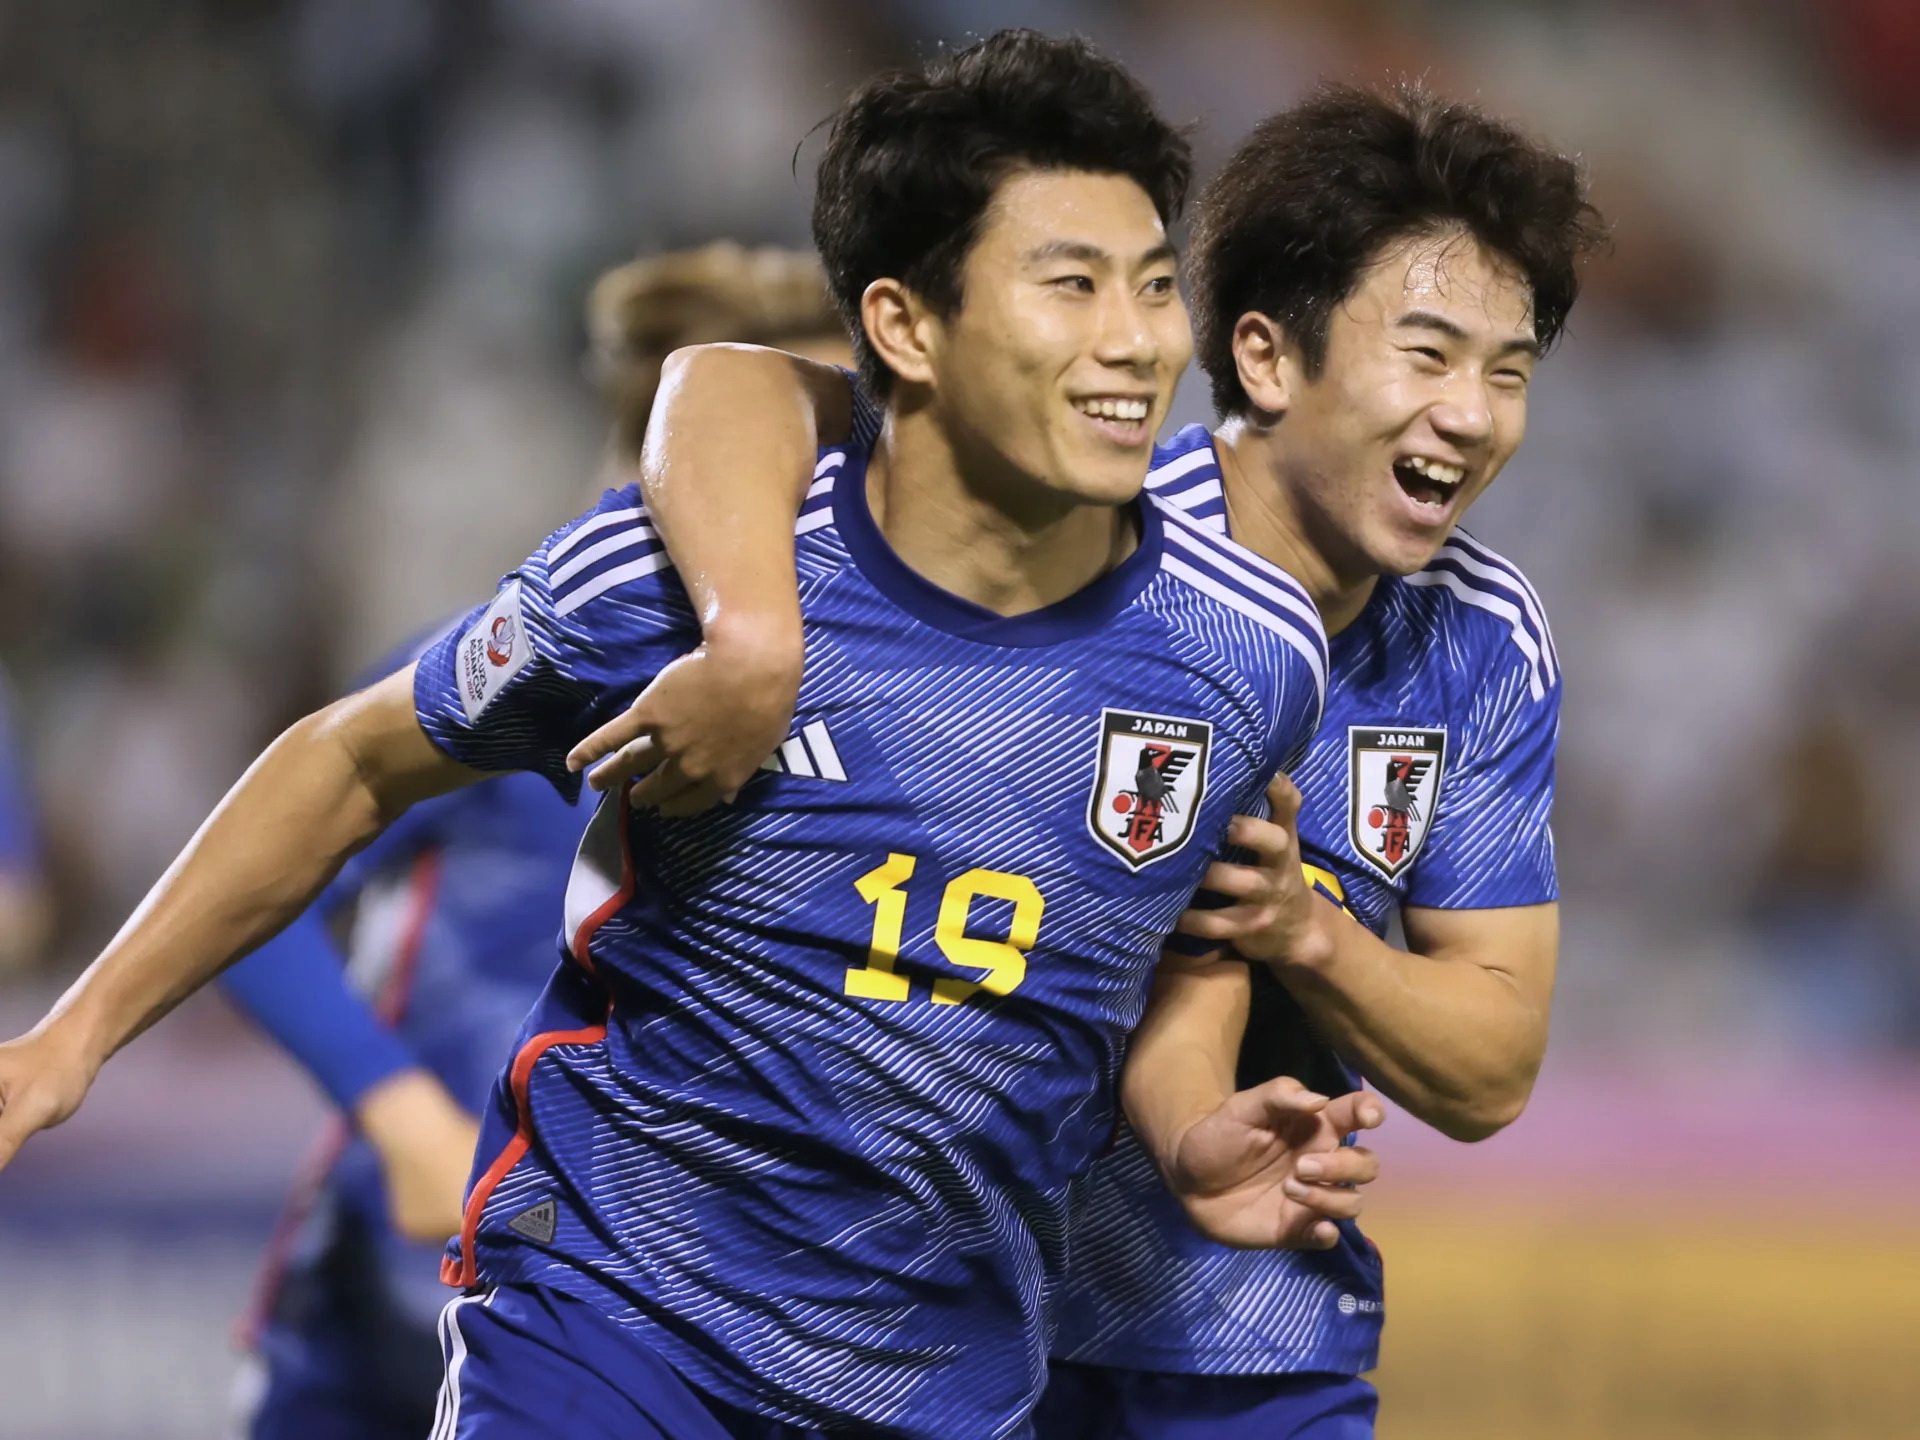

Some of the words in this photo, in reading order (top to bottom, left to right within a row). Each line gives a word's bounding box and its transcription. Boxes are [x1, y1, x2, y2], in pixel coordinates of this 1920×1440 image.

[473, 674, 483, 700] CUP
[478, 662, 487, 687] U23
[1131, 719, 1188, 738] JAPAN
[1377, 734, 1425, 747] JAPAN
[1117, 816, 1163, 843] JFA
[1376, 831, 1410, 853] JFA
[844, 852, 1046, 1006] 19
